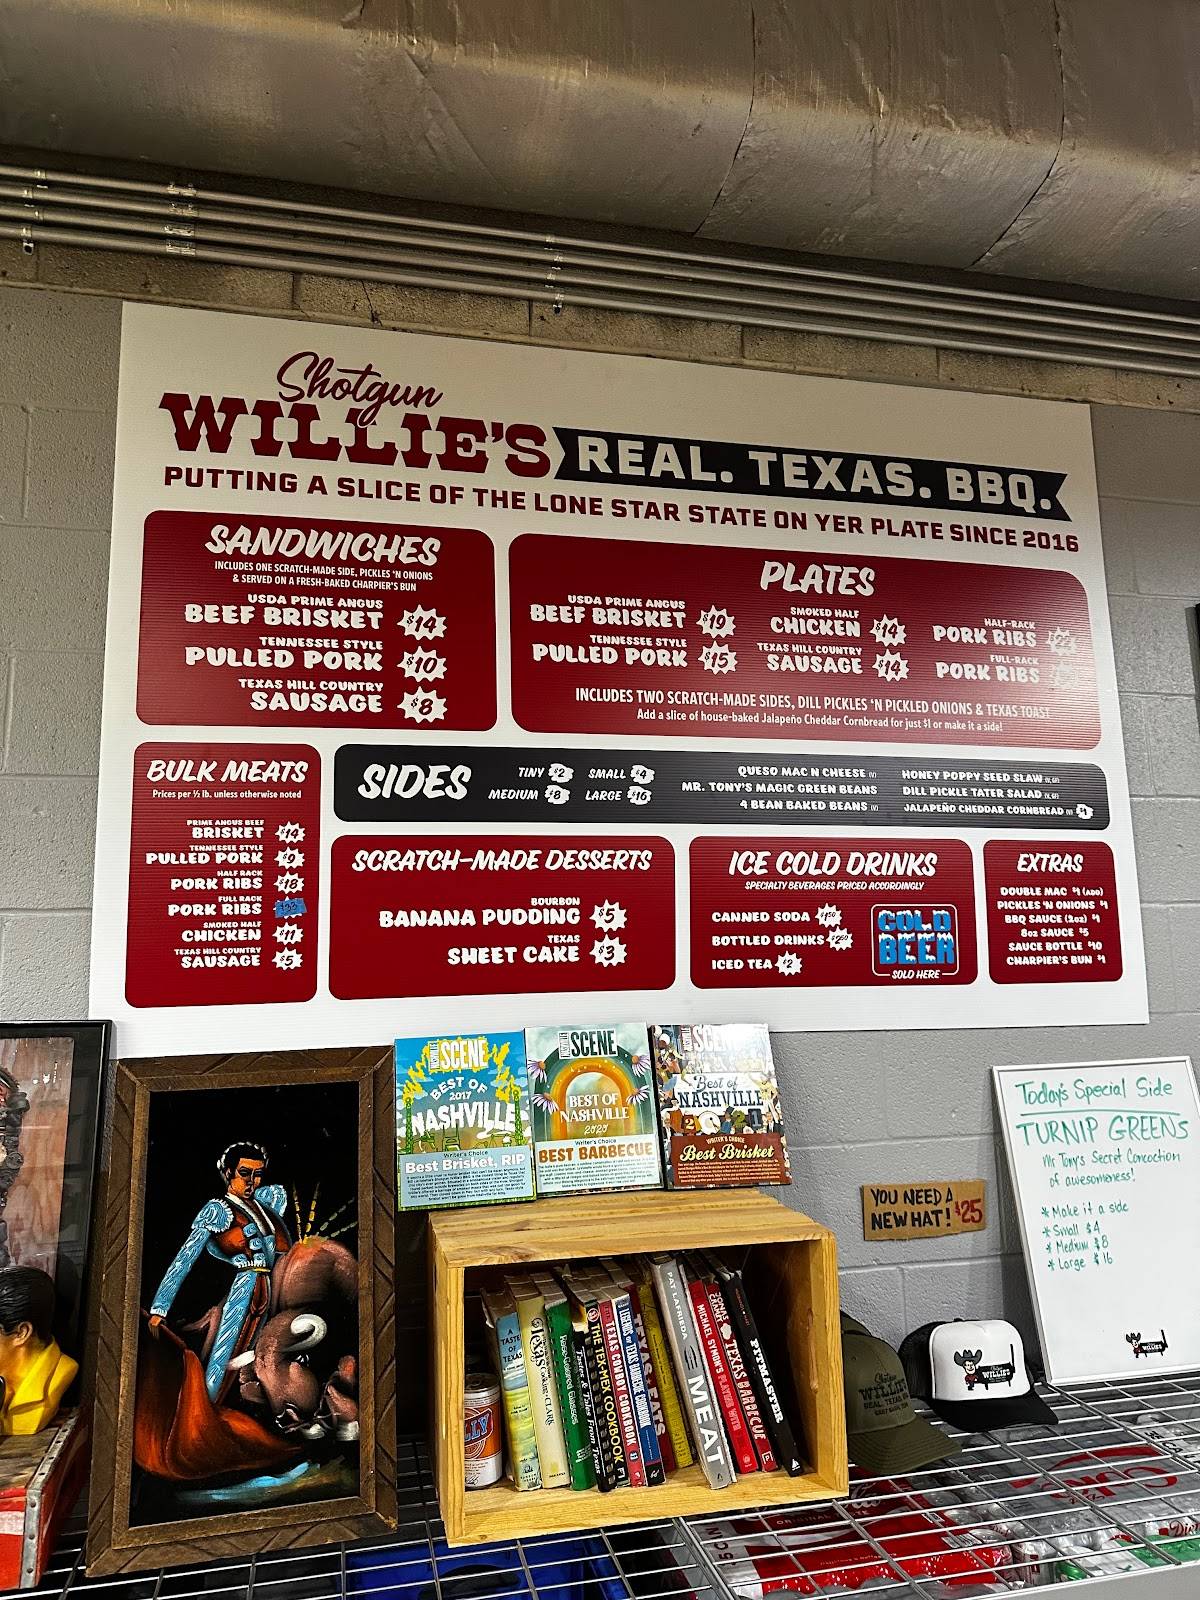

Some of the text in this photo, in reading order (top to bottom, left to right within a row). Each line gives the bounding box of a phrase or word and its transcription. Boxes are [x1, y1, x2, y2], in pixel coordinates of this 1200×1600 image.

[276, 351, 444, 428] Shotgun
[159, 393, 551, 478] WILLIE'S
[577, 435, 1052, 512] REAL. TEXAS. BBQ.
[164, 466, 1079, 553] PUTTING A SLICE OF THE LONE STAR STATE ON YER PLATE SINCE 2016
[205, 524, 441, 566] SANDWICHES
[214, 560, 253, 572] INCLUDES
[256, 562, 272, 573] ONE
[274, 563, 335, 576] SCRATCH-MADE
[338, 566, 357, 578] SIDE,
[359, 568, 390, 579] PICKLES
[403, 570, 433, 580] ONIONS
[760, 561, 876, 594] PLATES
[232, 574, 416, 591] & SERVED ON A FRESH-BAKED CHARPIER'S BUN
[248, 594, 383, 608] USDA PRIME ANGUS
[185, 604, 437, 633] BEEF BRISKET $14
[530, 604, 726, 630] BEEF BRISKET $19
[790, 607, 859, 618] SMOKED HALF
[770, 616, 898, 638] CHICKEN $14
[984, 618, 1036, 630] HALF-RACK
[932, 626, 1036, 647] PORK RIBS
[186, 647, 436, 675] PULLED PORK $10
[238, 679, 383, 692] TEXAS HILL COUNTRY
[250, 692, 434, 716] SAUSAGE $8
[576, 688, 633, 702] INCLUDES
[637, 690, 664, 704] TWO
[668, 692, 756, 707] SCRATCH-MADE
[760, 695, 795, 710] SIDES,
[798, 696, 821, 709] DILL
[824, 697, 868, 711] PICKLES
[886, 700, 929, 713] PICKLED
[932, 701, 972, 714] ONIONS
[976, 704, 984, 715] &
[986, 704, 1018, 717] TEXAS
[1020, 705, 1050, 718] TOAST
[147, 760, 308, 783] BULK MEATS
[357, 764, 472, 800] SIDES
[518, 767, 647, 780] TINY $2 SMALL $4
[152, 790, 176, 798] Prices
[178, 791, 191, 799] per
[214, 790, 238, 798] unless
[240, 790, 278, 798] otherwise
[280, 790, 302, 798] noted
[488, 789, 539, 800] MEDIUM
[585, 790, 622, 801] LARGE
[682, 782, 877, 794] MR. TONY'S MAGIC GREEN BEANS
[903, 787, 1042, 799] DILL PICKLE TATER SALAD
[146, 853, 295, 864] PULLED PORK $9
[352, 849, 653, 872] SCRATCH-MADE DESSERTS
[729, 851, 938, 876] ICE COLD DRINKS
[1017, 853, 1083, 872] EXTRAS
[745, 881, 924, 890] SPECIALTY BEVERAGES PRICED ACCORDINGLY
[531, 897, 580, 906] BOURBON
[379, 908, 615, 928] BANANA PUDDING $5
[182, 929, 295, 942] CHICKEN $11
[712, 935, 824, 946] BOTTLED DRINKS
[1008, 941, 1102, 951] SAUCE BOTTLE $10
[181, 955, 293, 968] SAUSAGE $5
[441, 1039, 487, 1069] SCENE
[1015, 1076, 1173, 1106] Today's Special Side
[412, 1102, 515, 1137] NASHVILLE
[1015, 1115, 1189, 1146] TURNIP GREENS
[538, 1143, 653, 1163] BEST BARBECUE
[680, 1144, 774, 1161] Best Brisket
[405, 1154, 525, 1174] Best Brisket, RIP
[871, 1188, 953, 1205] YOU NEED A
[872, 1210, 951, 1230] NEW HAT!
[954, 1199, 982, 1224] $25
[666, 1271, 687, 1340] PAT LAFRIEDA
[605, 1321, 638, 1446] TEXAS COWBOY COOKBOOK
[750, 1338, 784, 1424] PITMASTER
[689, 1375, 725, 1466] MEAT
